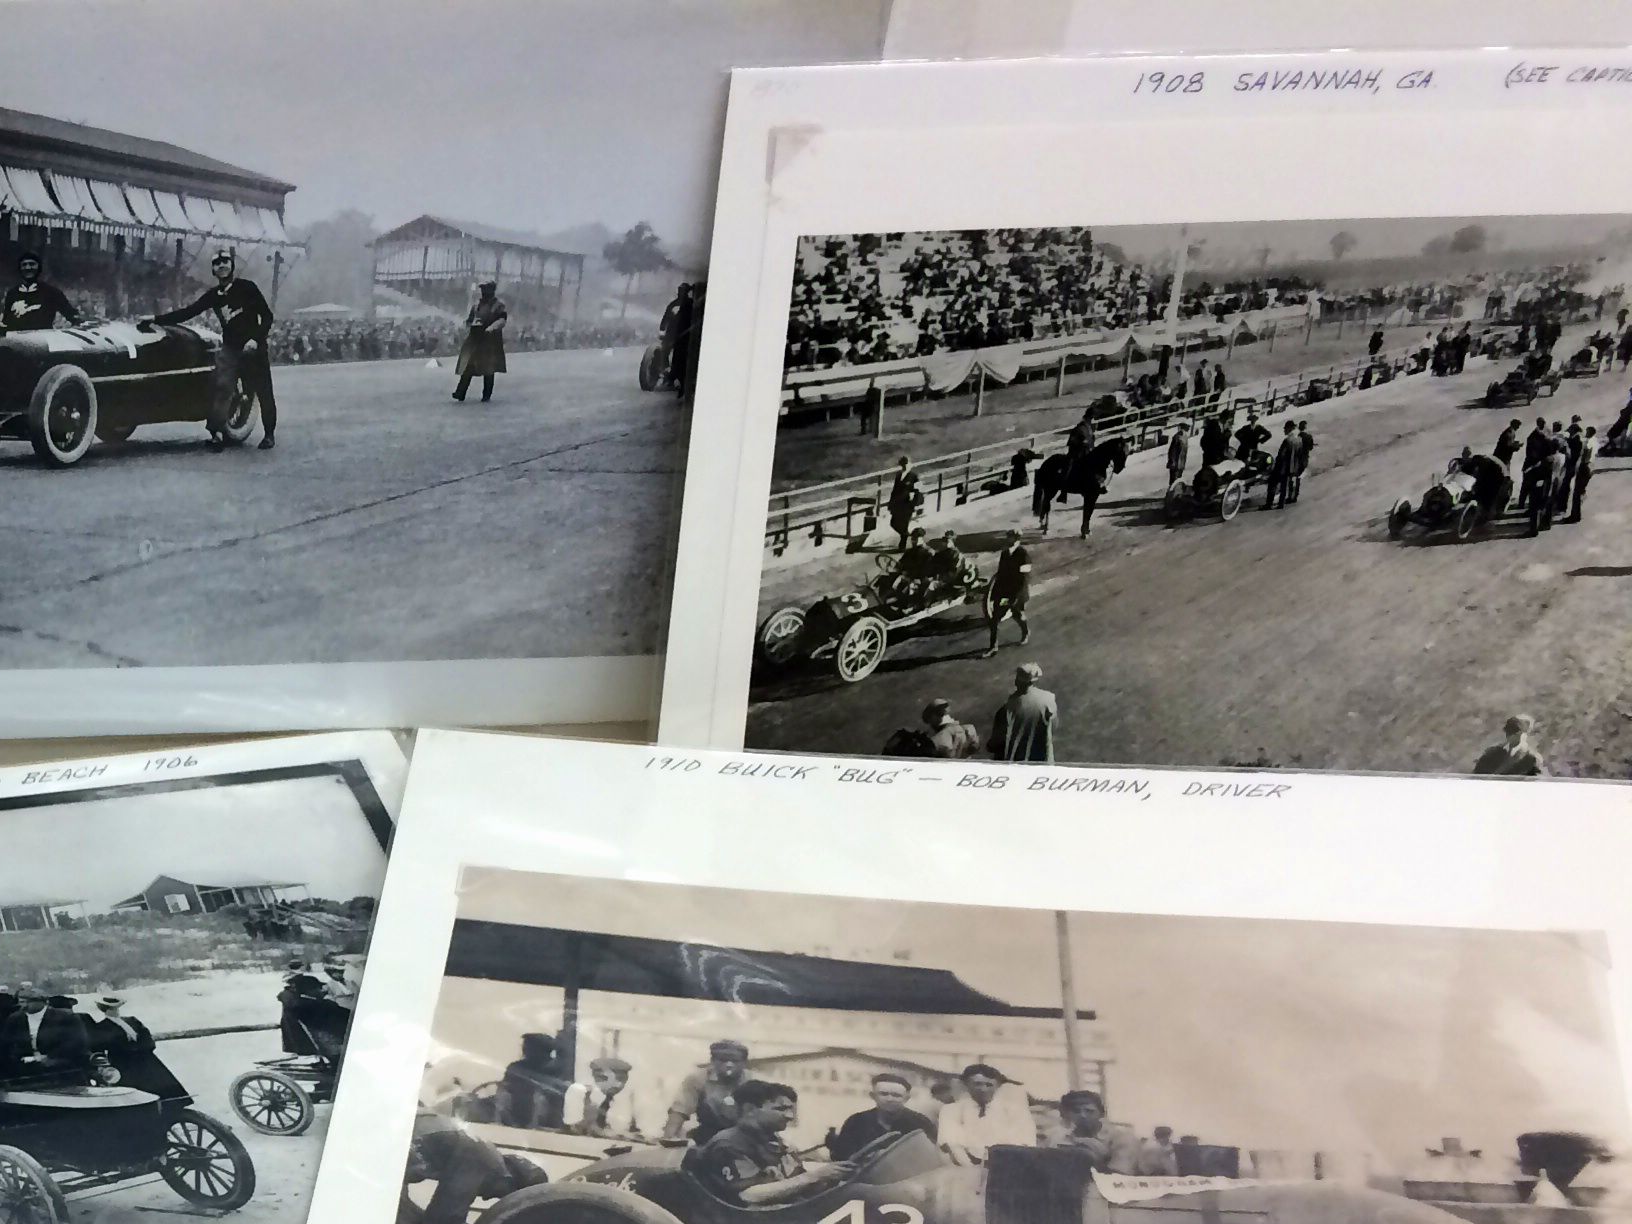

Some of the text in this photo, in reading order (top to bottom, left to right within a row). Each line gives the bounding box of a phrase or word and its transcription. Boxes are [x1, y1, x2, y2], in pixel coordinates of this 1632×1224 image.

[1133, 70, 1205, 94] 1908
[1233, 69, 1382, 94] SAVANNAH,
[1504, 61, 1560, 88] (SEE
[962, 561, 977, 584] 3
[840, 592, 869, 614] 3
[21, 764, 109, 786] BEACH
[144, 756, 199, 772] 1906
[644, 757, 701, 771] 1910
[718, 761, 819, 781] BUICK
[956, 773, 1011, 790] BOB
[1027, 776, 1152, 801] BURMAN,
[1181, 781, 1292, 799] DRIVER
